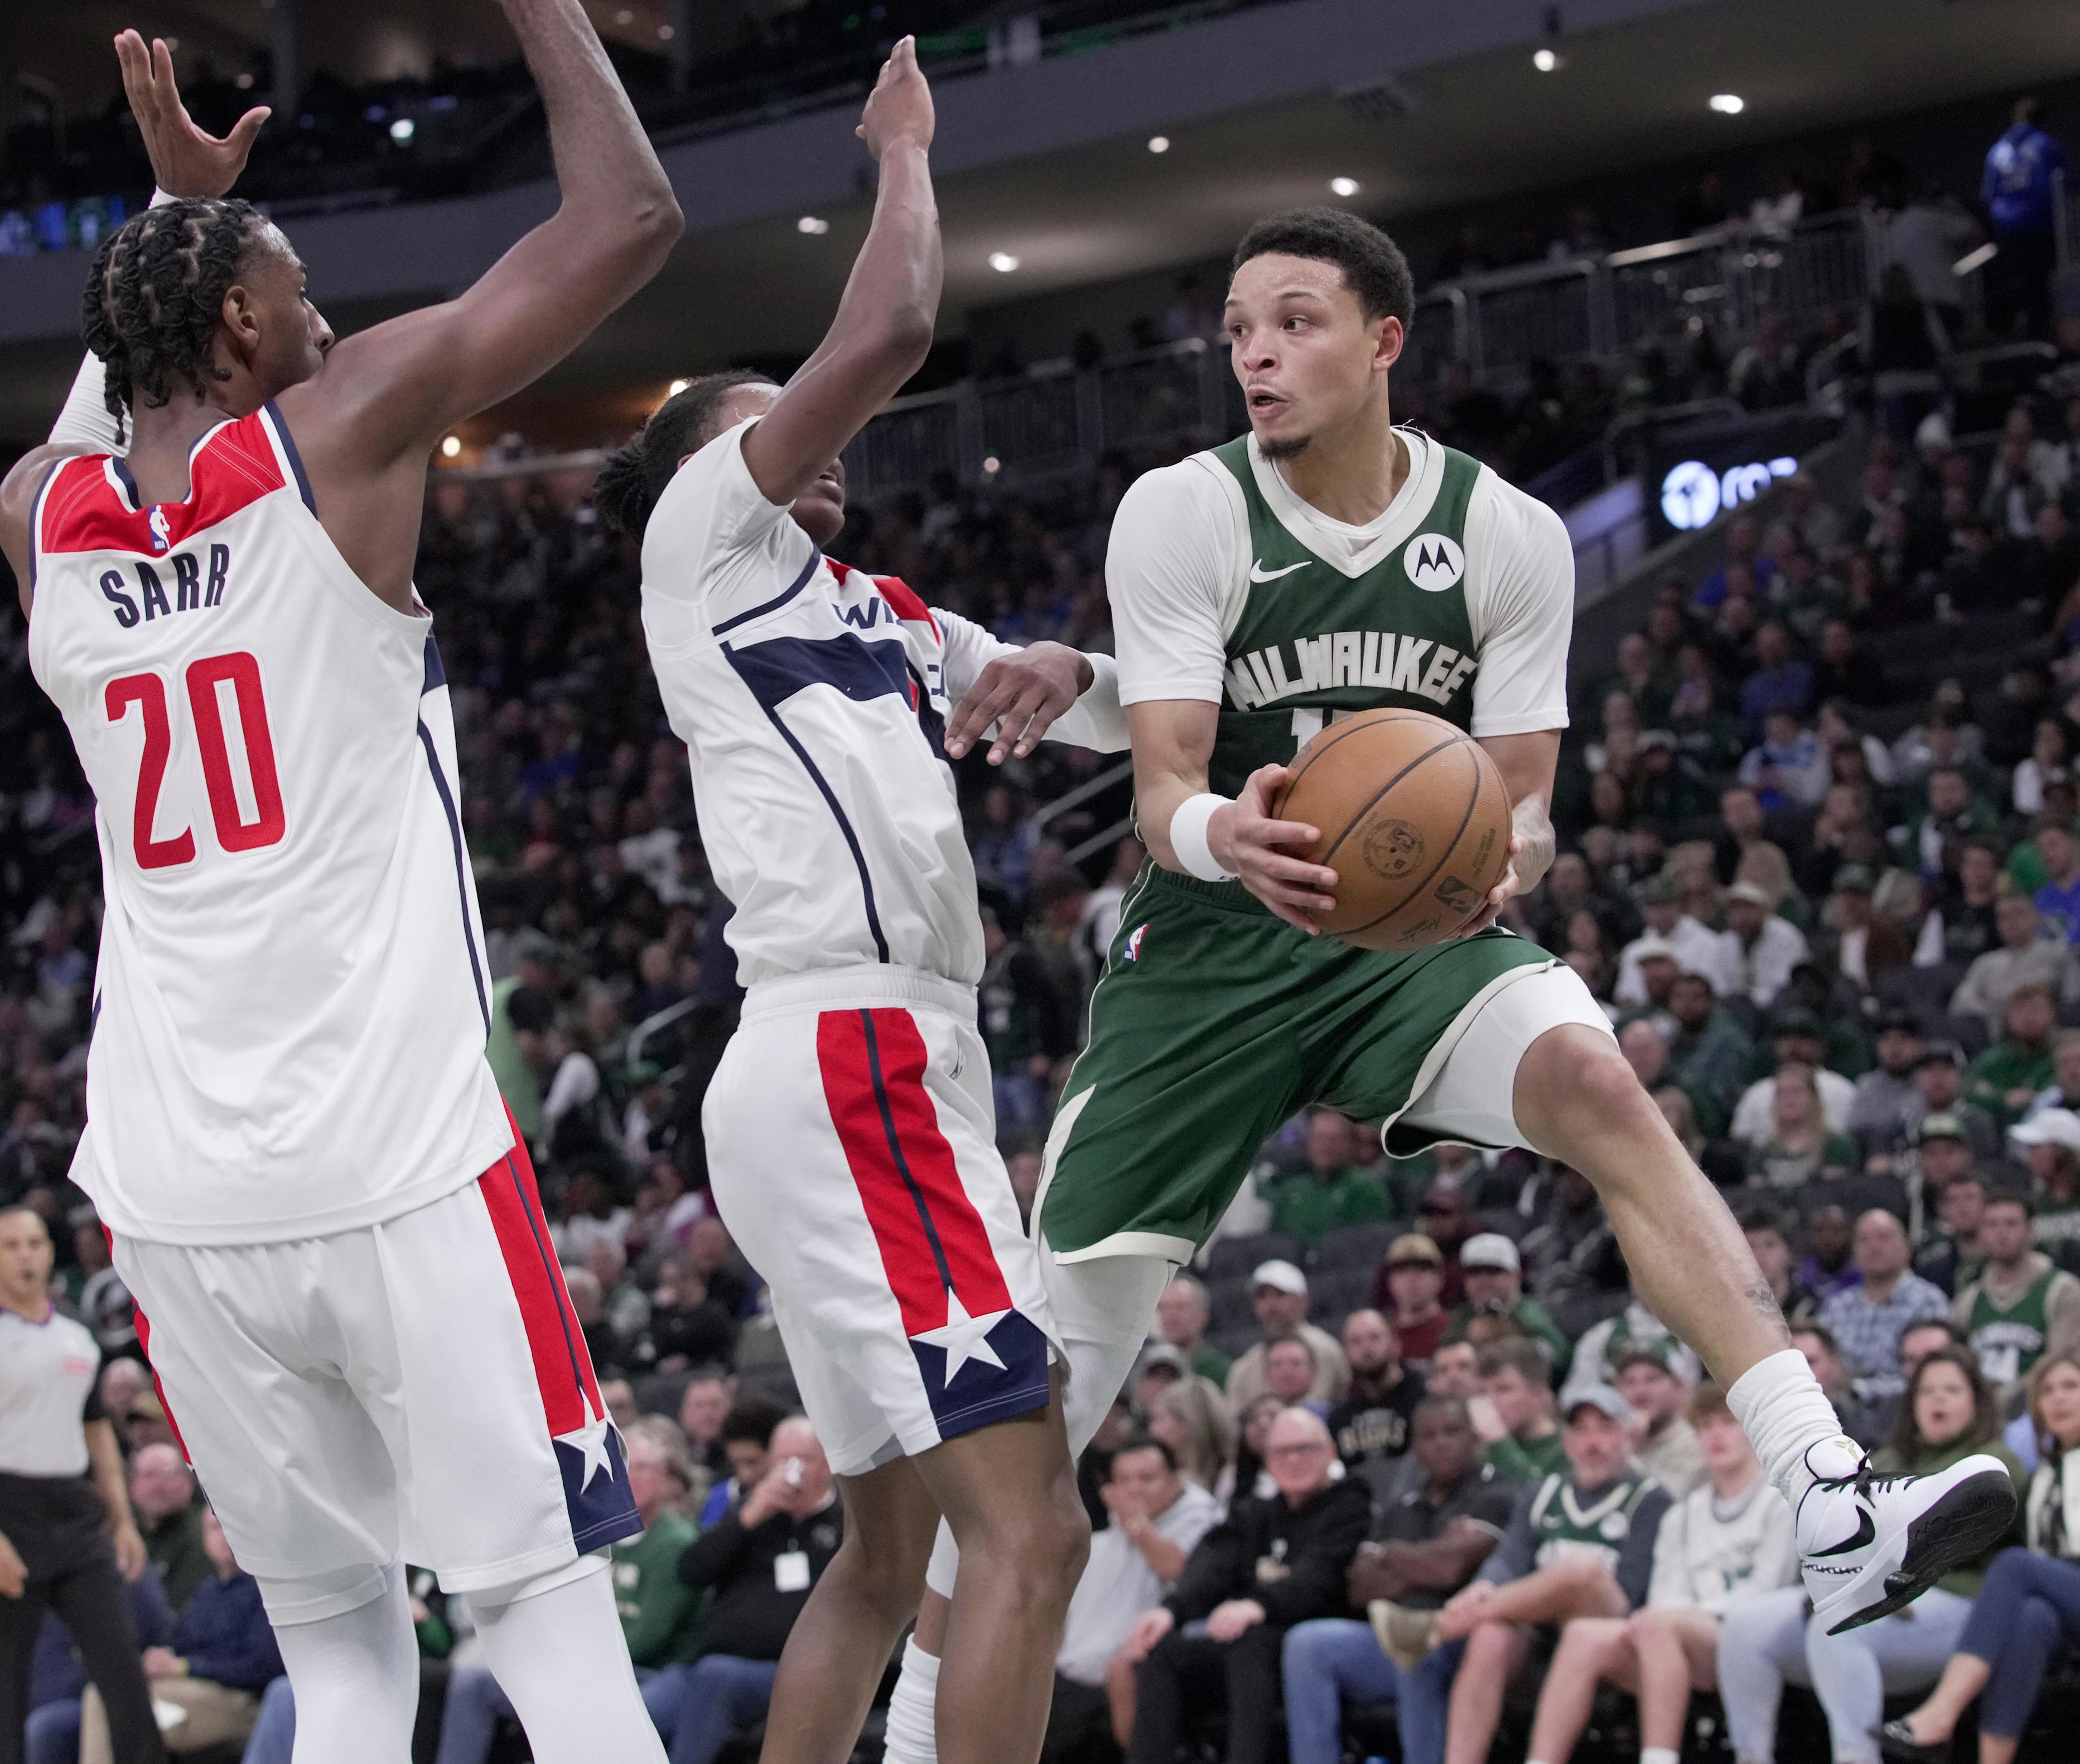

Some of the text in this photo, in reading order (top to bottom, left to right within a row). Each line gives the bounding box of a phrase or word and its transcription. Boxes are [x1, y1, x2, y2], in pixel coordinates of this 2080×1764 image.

[100, 544, 229, 628] SARR
[155, 540, 166, 550] NBA
[1224, 631, 1478, 712] MILWAUKEE
[105, 651, 286, 869] 20
